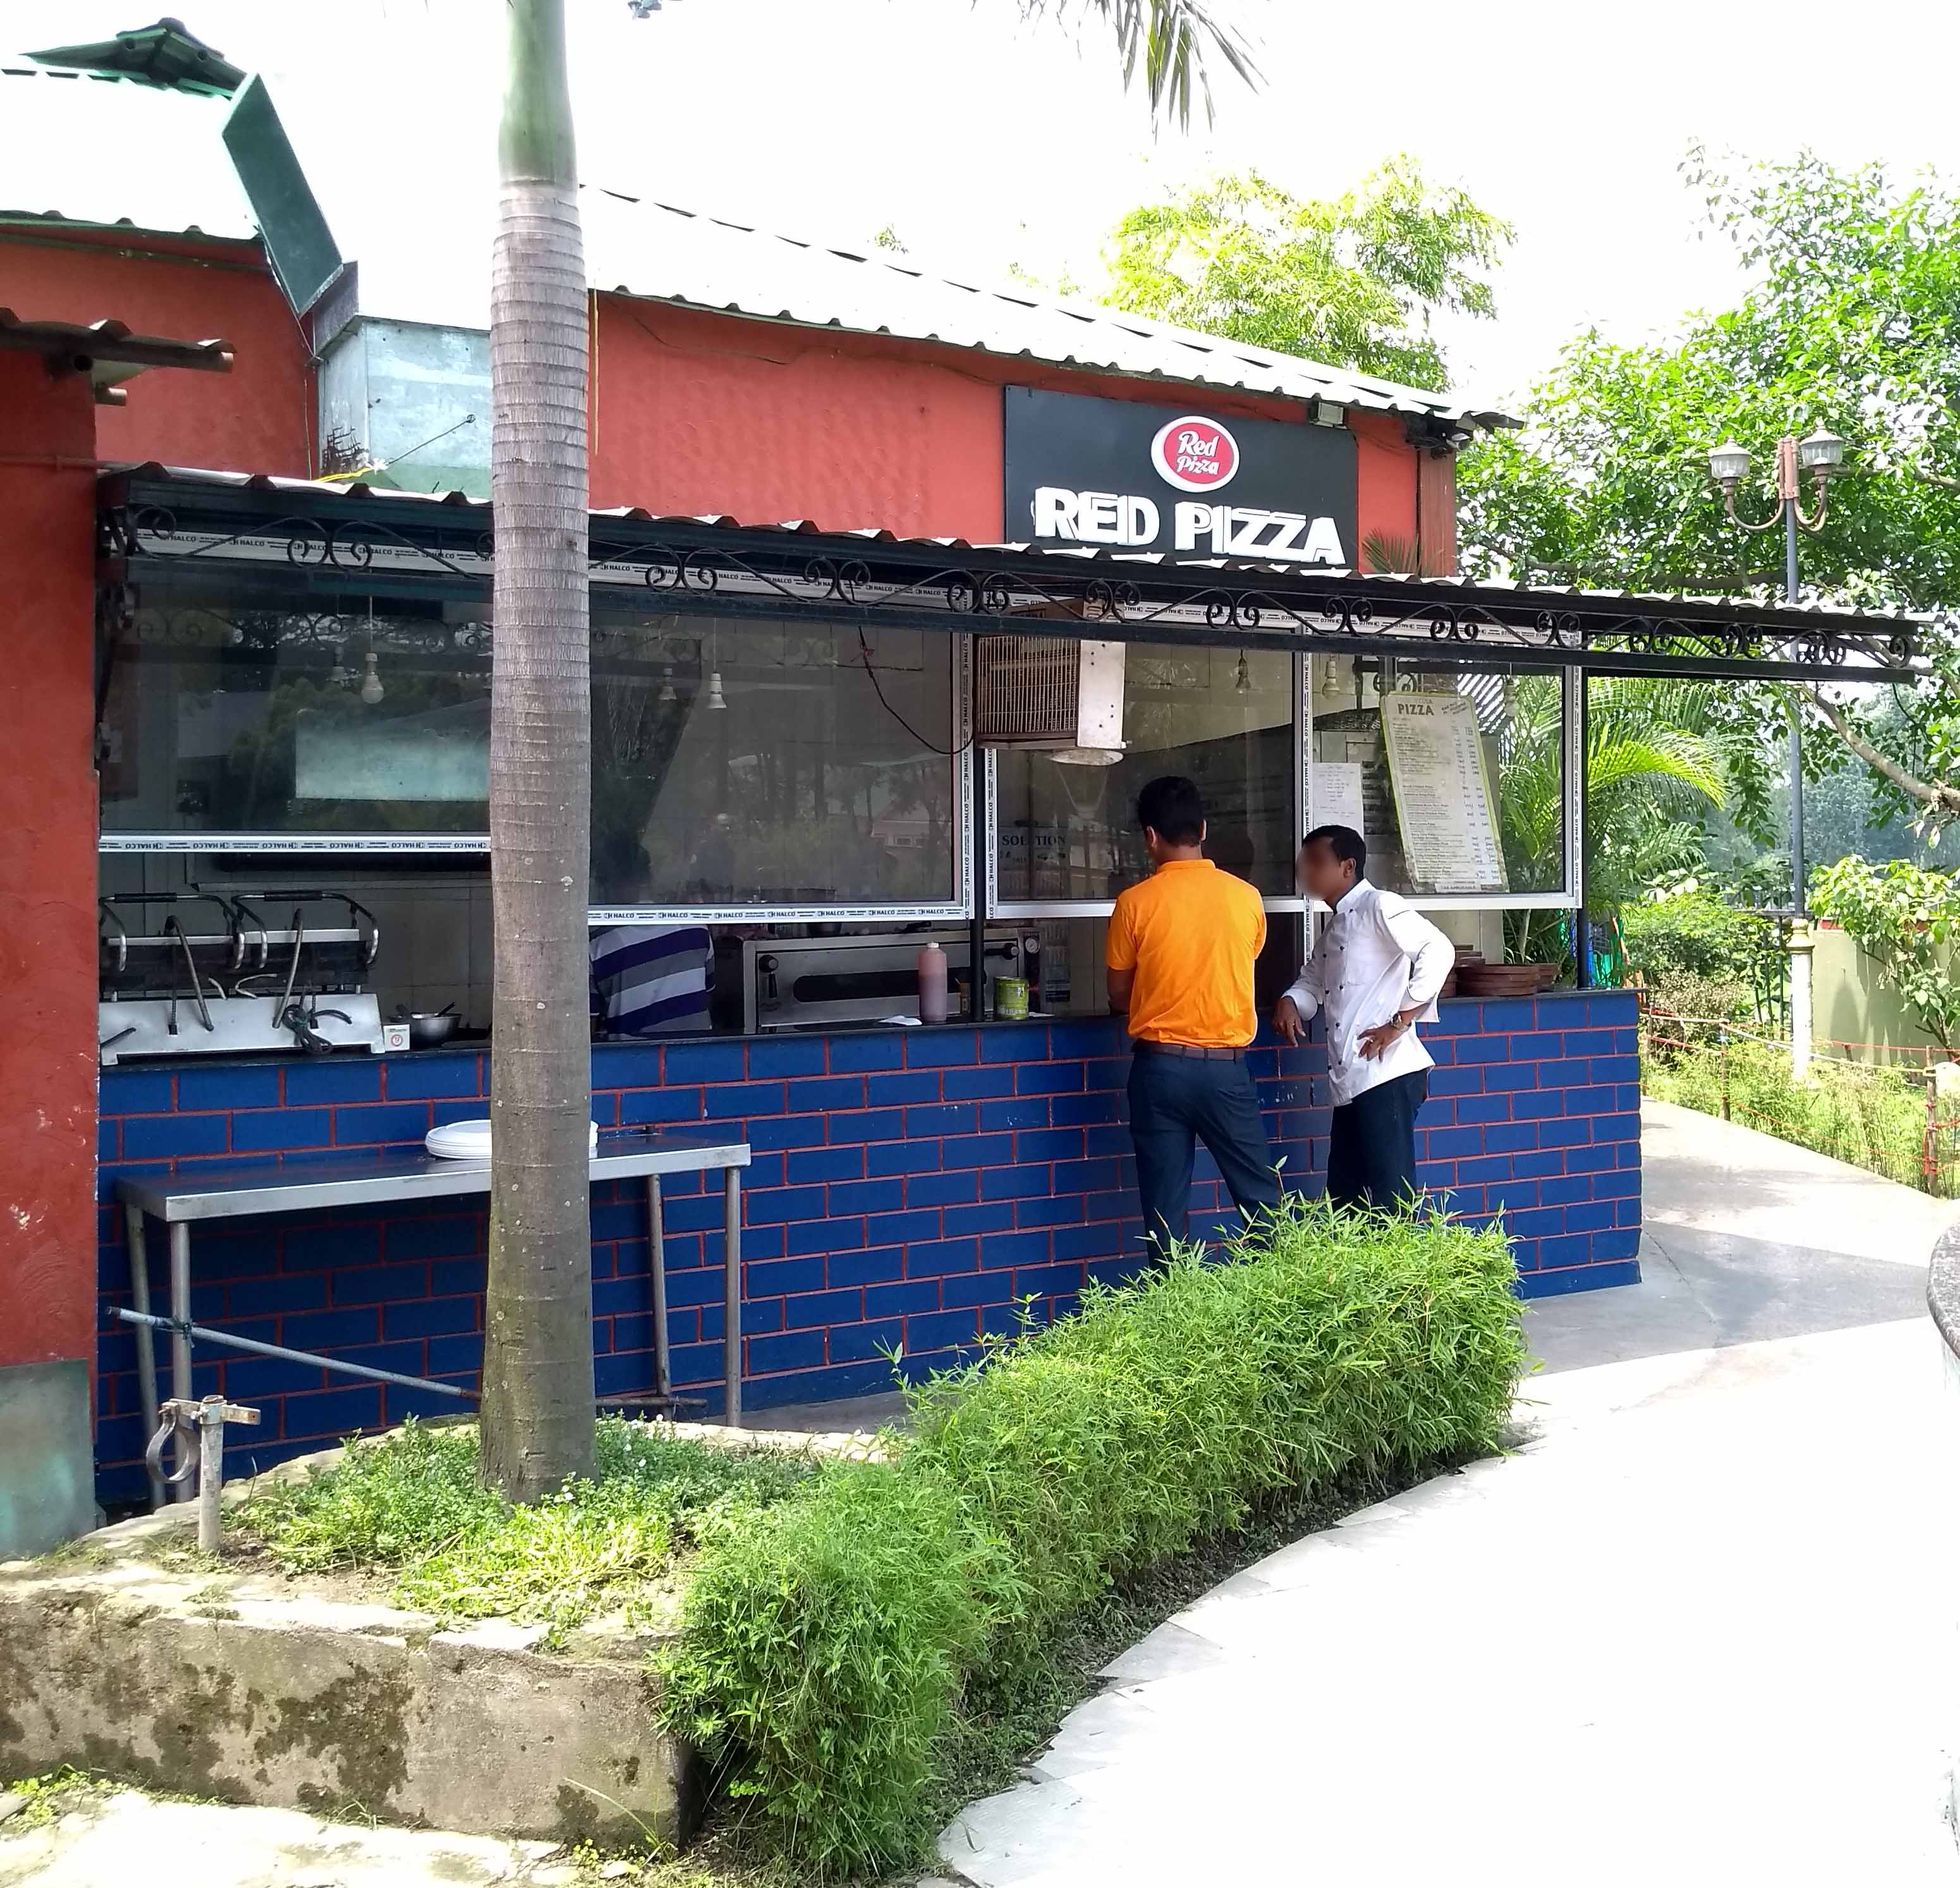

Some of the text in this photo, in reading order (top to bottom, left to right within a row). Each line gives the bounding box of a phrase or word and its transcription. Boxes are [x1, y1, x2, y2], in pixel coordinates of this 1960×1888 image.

[1178, 430, 1219, 458] Red
[1176, 455, 1220, 477] Pizza
[1030, 486, 1346, 565] RED PIZZA
[1397, 703, 1435, 716] PIZZA
[1001, 834, 1066, 846] SOLTION
